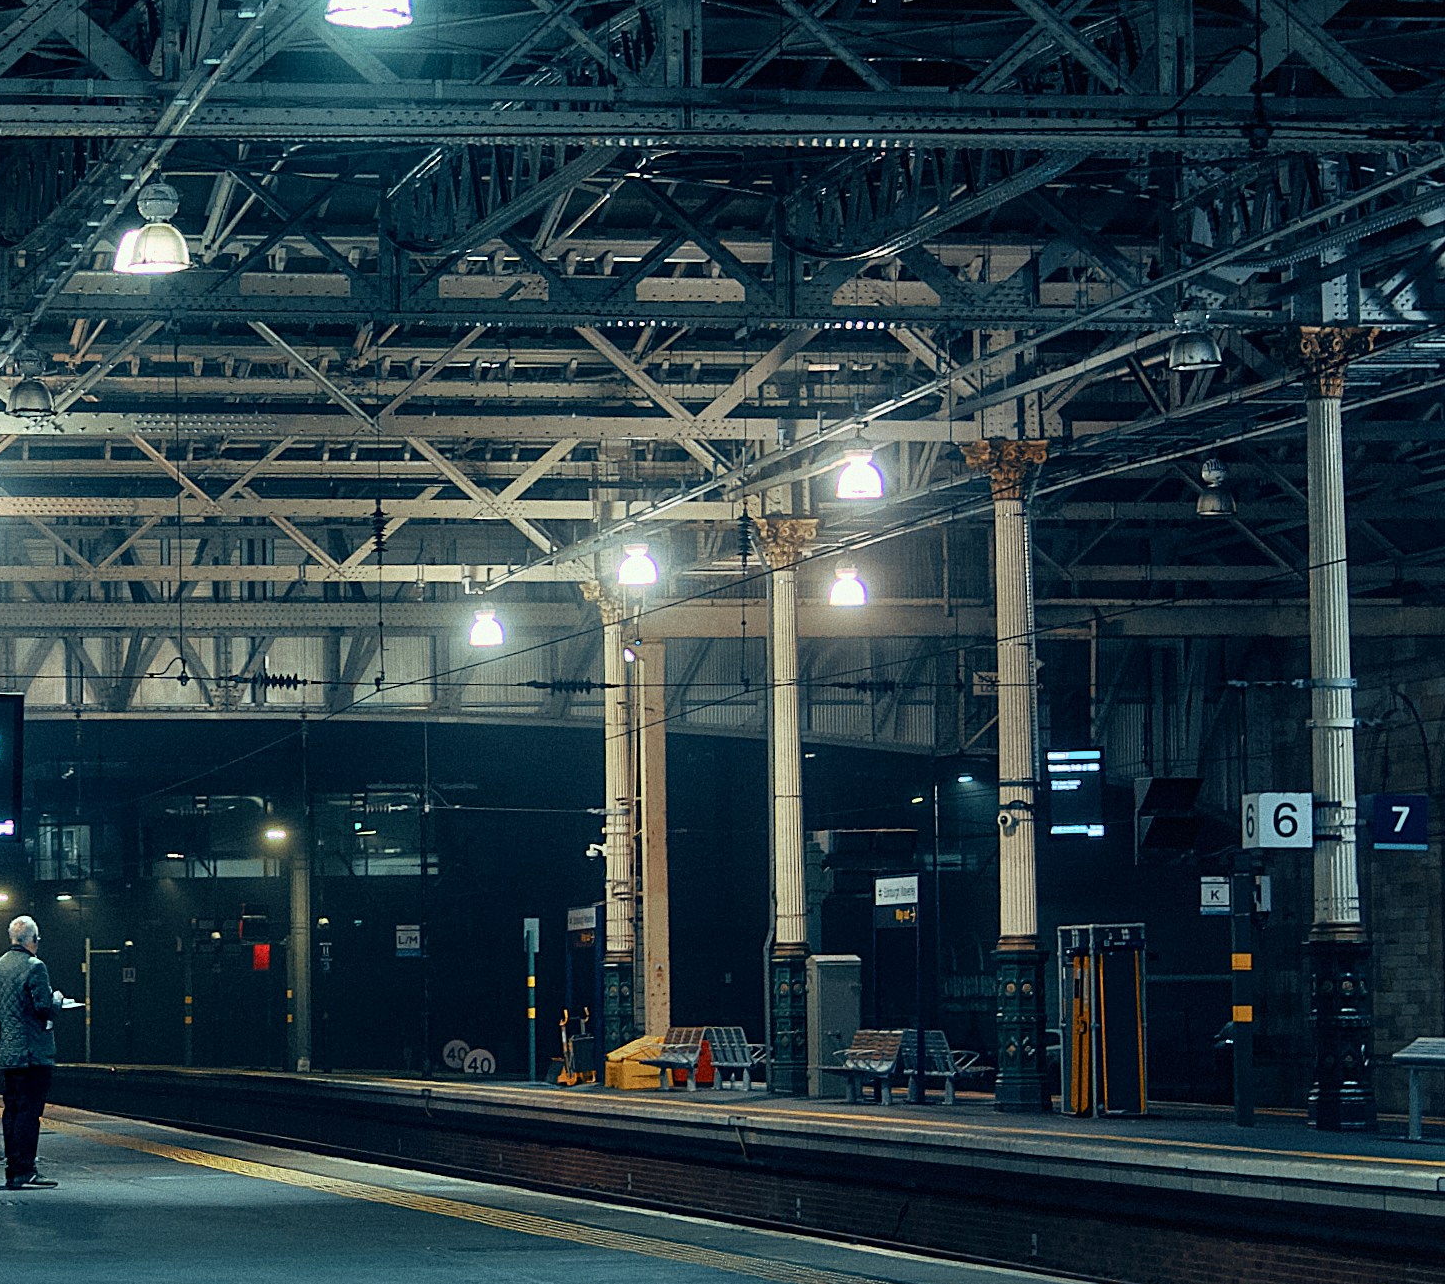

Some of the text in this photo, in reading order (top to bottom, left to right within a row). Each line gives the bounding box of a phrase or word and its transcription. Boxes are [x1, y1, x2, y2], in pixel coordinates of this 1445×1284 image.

[1246, 803, 1255, 838] 6
[1273, 802, 1299, 838] 6
[1391, 806, 1411, 833] 7
[1211, 890, 1219, 901] K
[398, 935, 418, 945] L/M
[446, 1046, 467, 1062] 40
[468, 1057, 491, 1074] 40
